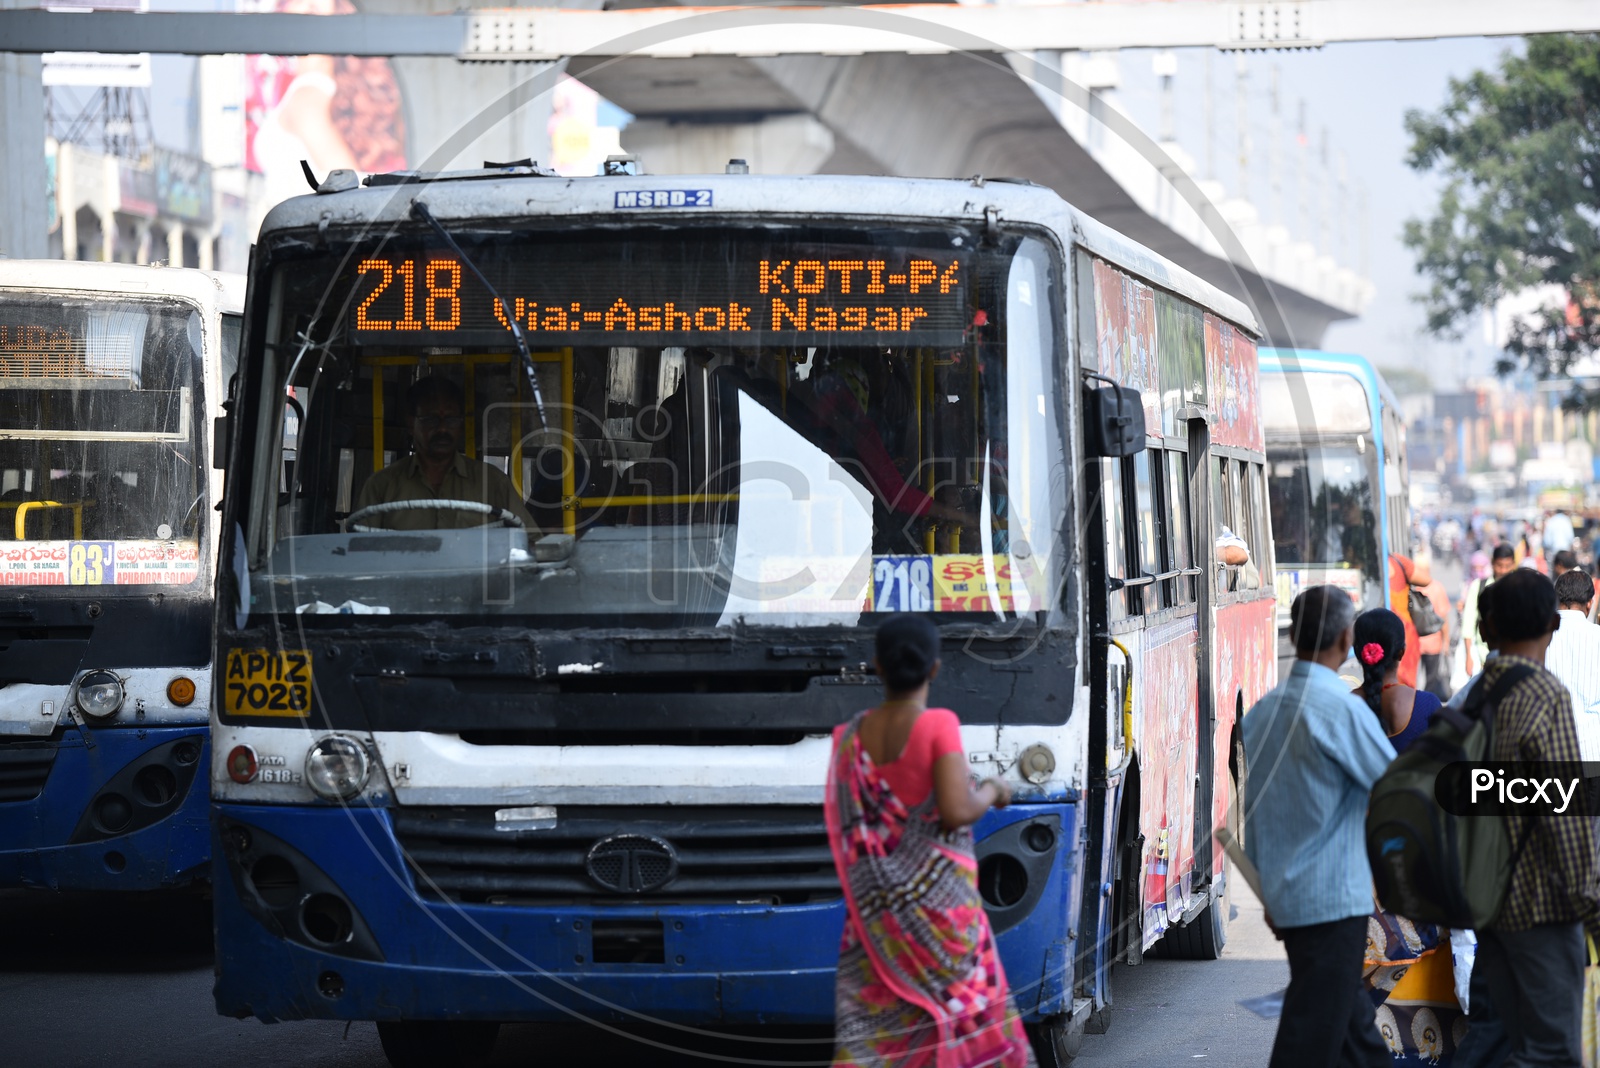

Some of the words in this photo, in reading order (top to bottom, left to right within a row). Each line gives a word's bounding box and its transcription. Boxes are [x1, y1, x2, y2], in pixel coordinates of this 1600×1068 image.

[616, 190, 711, 207] MSRD-2
[357, 259, 461, 331] 218
[771, 297, 928, 331] Nagar
[875, 559, 930, 612] 218
[228, 683, 308, 710] 7028
[258, 755, 285, 765] TATA
